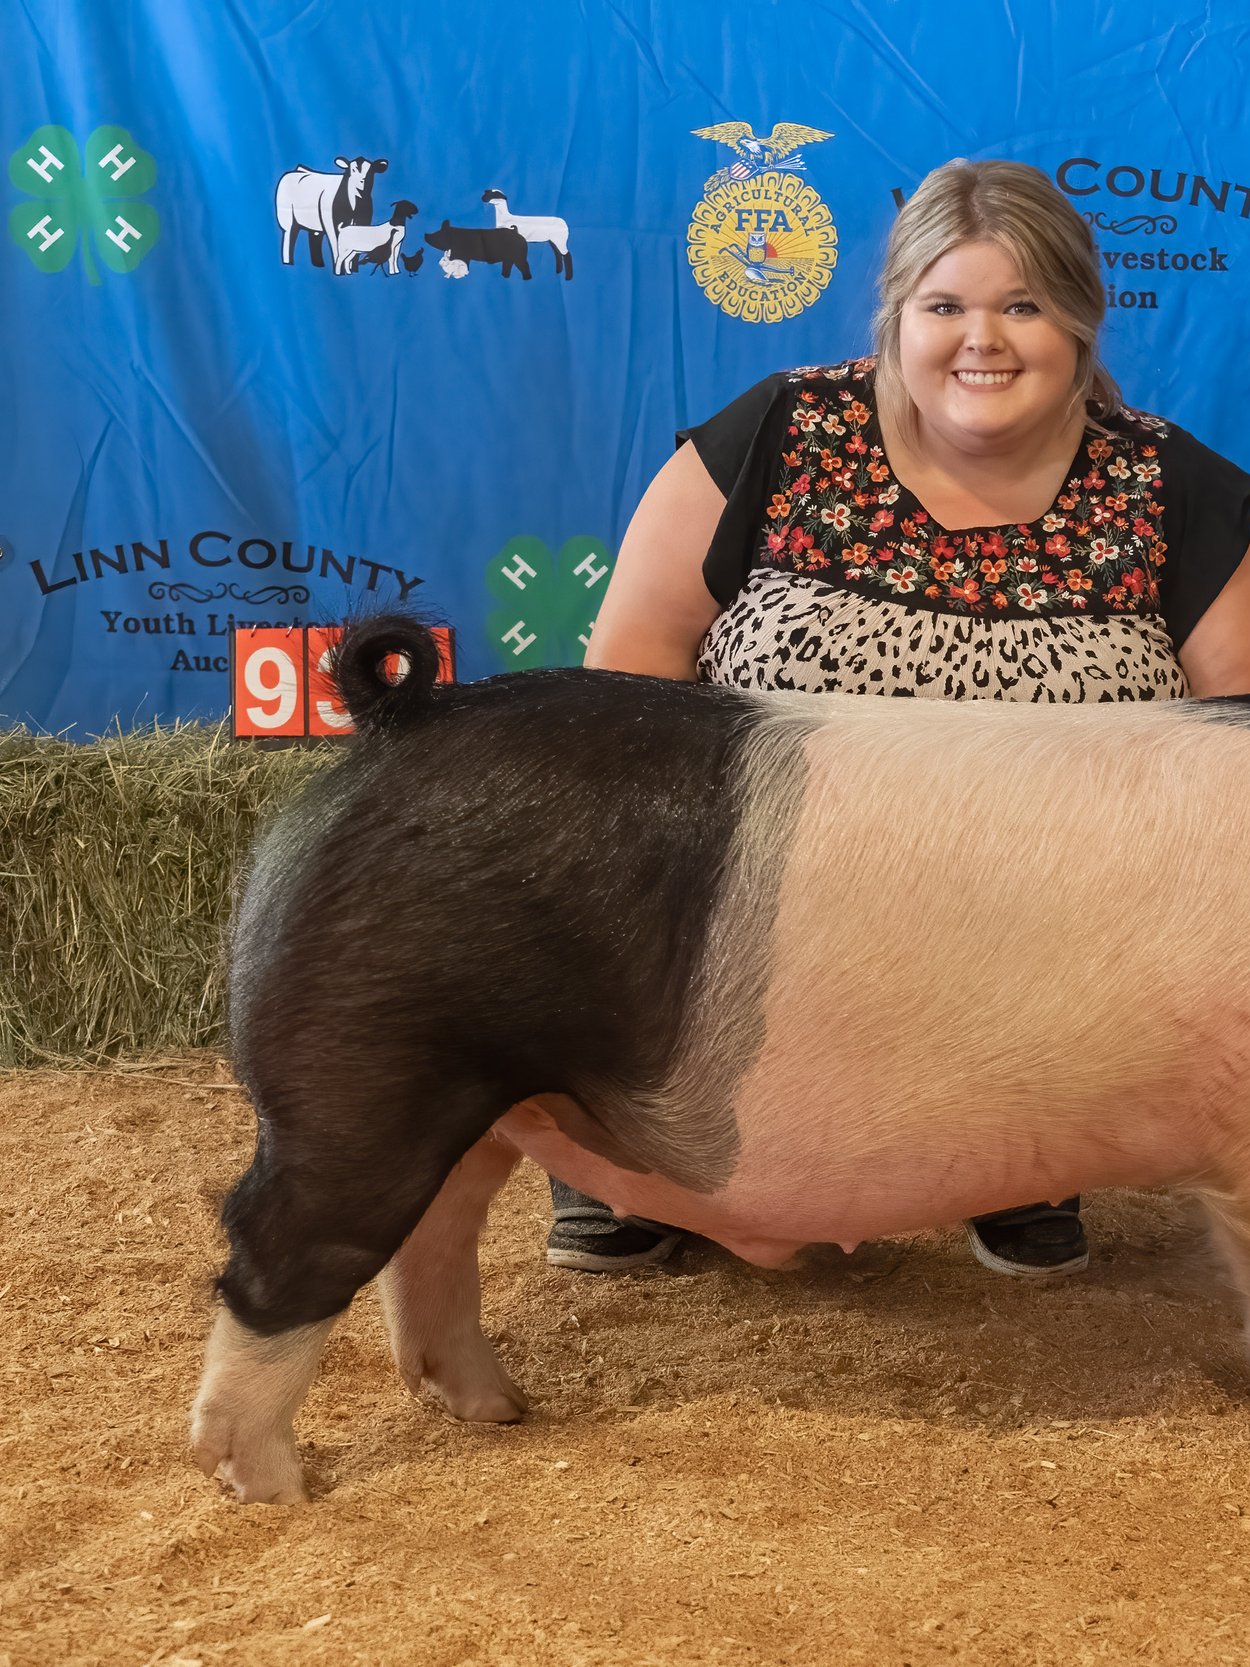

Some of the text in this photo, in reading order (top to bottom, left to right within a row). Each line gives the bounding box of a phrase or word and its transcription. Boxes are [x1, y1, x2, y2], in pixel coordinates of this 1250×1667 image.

[27, 145, 65, 183] H
[98, 144, 136, 181] H
[711, 189, 816, 236] AGRICULTURAL
[735, 209, 793, 232] FFA
[27, 215, 64, 252] H
[105, 216, 142, 253] H
[1096, 245, 1229, 271] vestock
[717, 271, 806, 302] EDUCATION
[30, 531, 425, 602] LINN COUNTY
[501, 554, 537, 590] H
[573, 553, 609, 589] H
[101, 611, 196, 635] Youth
[501, 620, 537, 656] H
